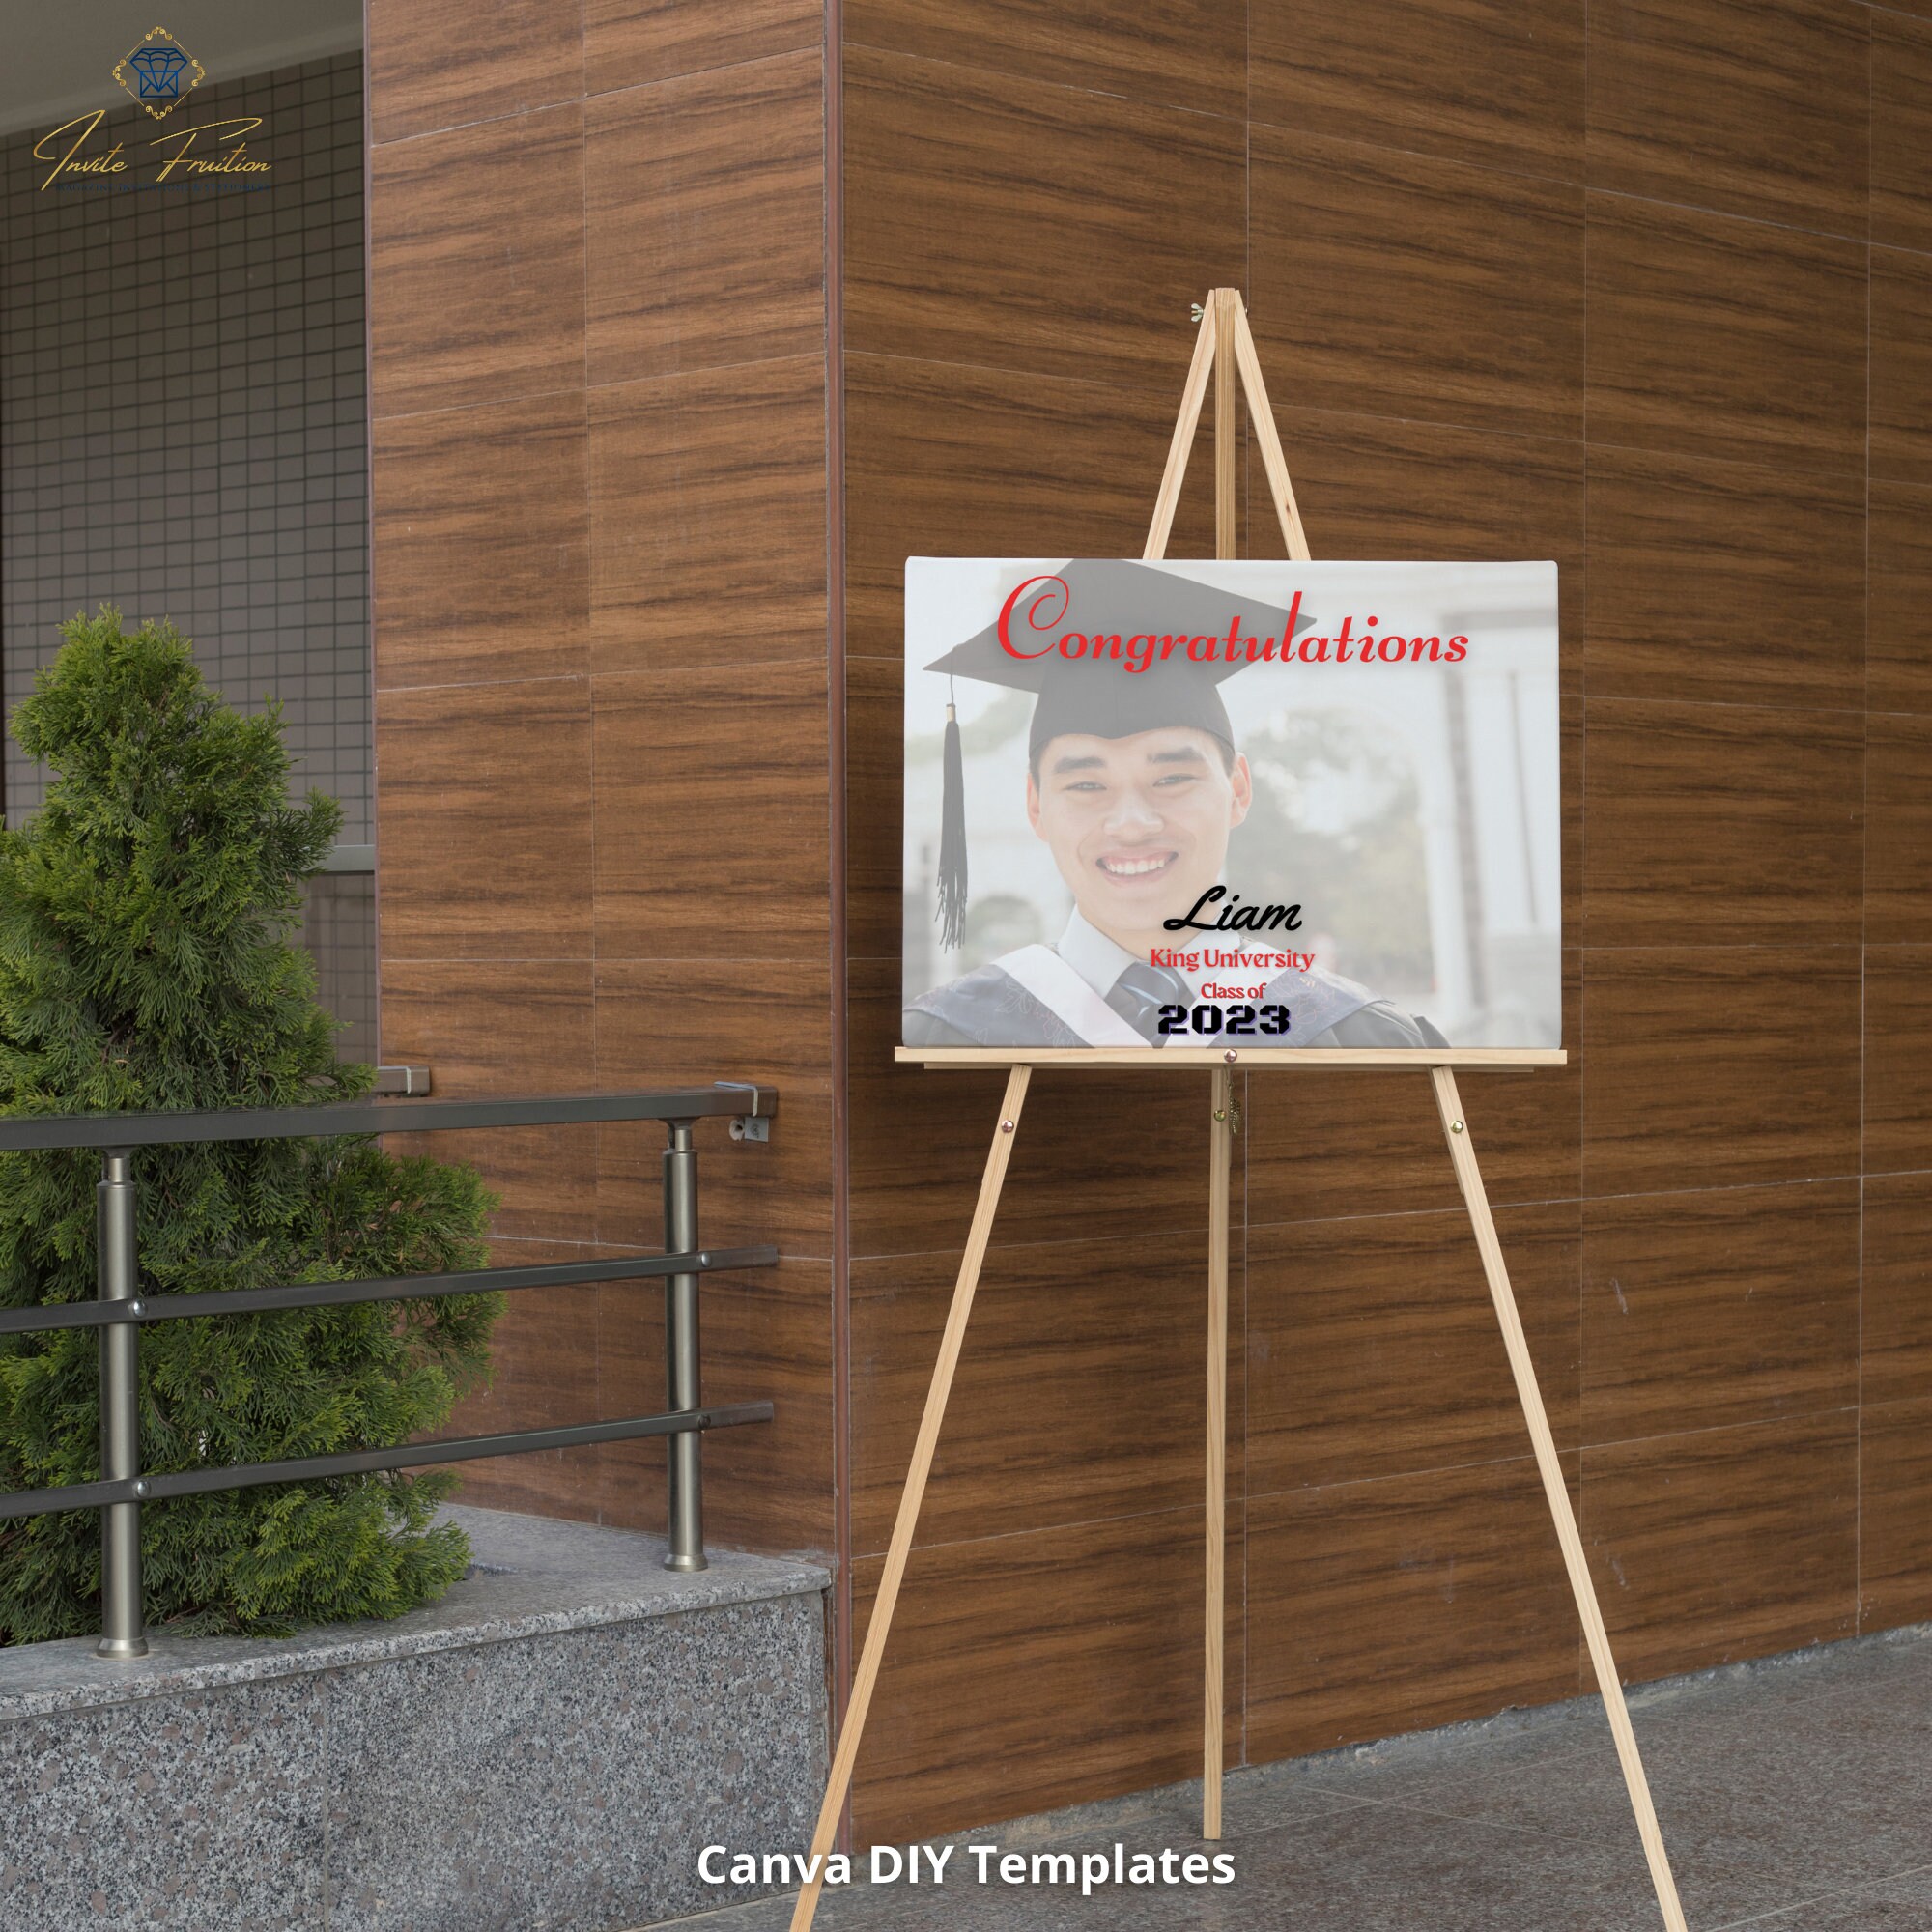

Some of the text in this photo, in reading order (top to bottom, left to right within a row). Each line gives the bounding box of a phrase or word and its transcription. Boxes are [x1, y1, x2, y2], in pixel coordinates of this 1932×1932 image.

[997, 575, 1469, 673] Congratulations
[1162, 885, 1303, 931] Liam
[1151, 948, 1316, 973] King University
[1201, 982, 1267, 1000] Class of
[1157, 1004, 1292, 1036] 2023
